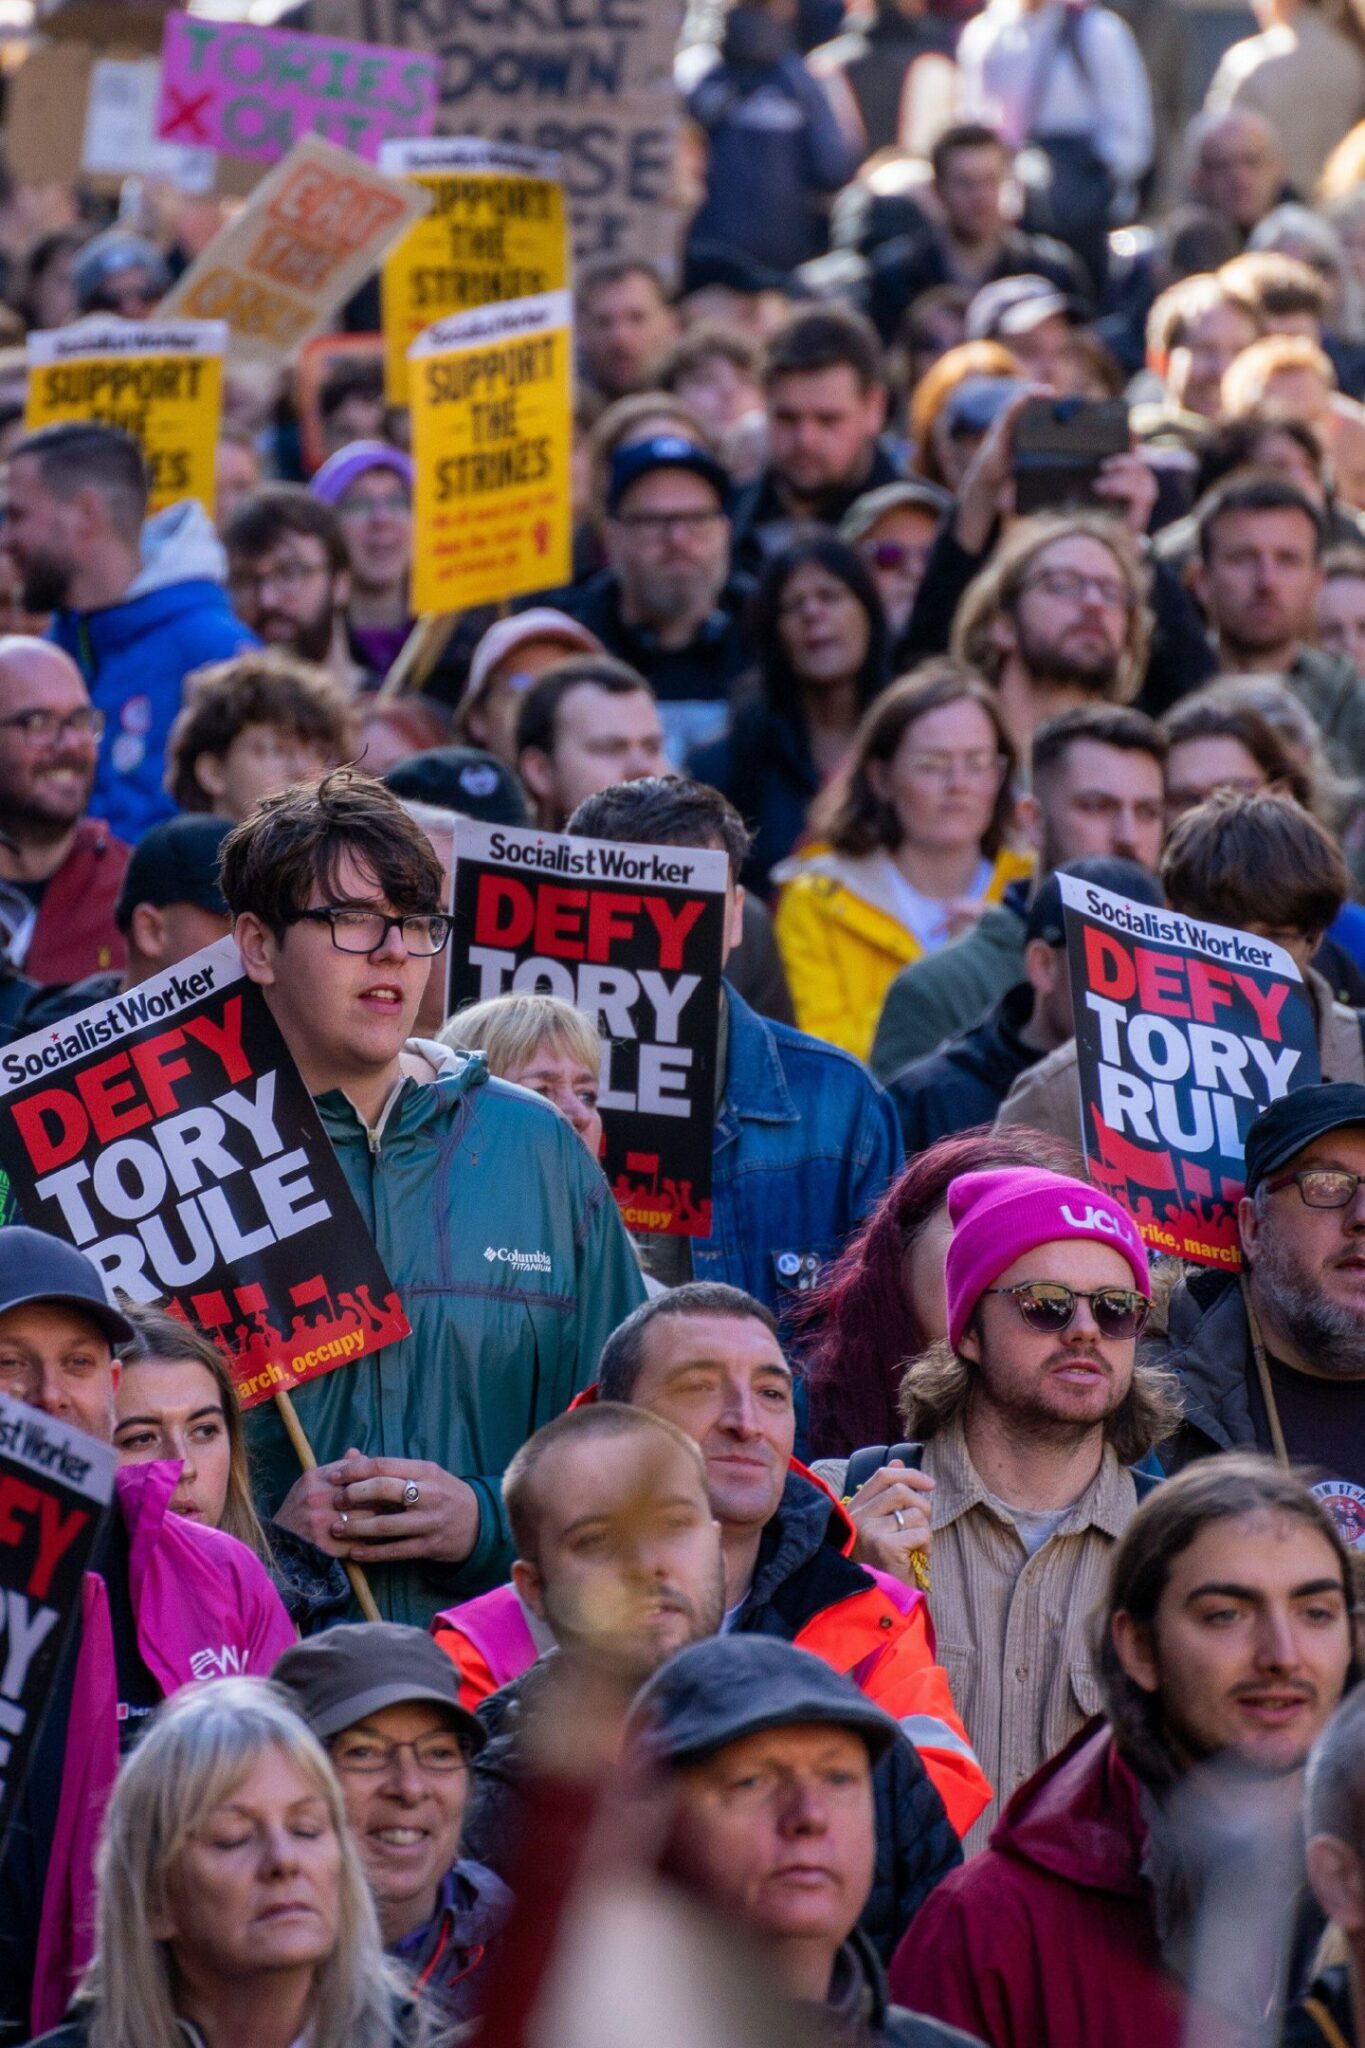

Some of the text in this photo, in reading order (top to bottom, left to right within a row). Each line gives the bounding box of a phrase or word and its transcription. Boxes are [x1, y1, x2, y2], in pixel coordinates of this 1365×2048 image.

[182, 25, 435, 117] TORIES
[437, 40, 624, 100] DOWN
[267, 162, 407, 249] EAT
[430, 180, 551, 220] UPPORT
[449, 223, 506, 262] THE
[44, 360, 205, 410] SUPPORT
[425, 336, 557, 403] SUPPORT
[470, 398, 518, 444] THE
[435, 437, 552, 502] STRIKES
[489, 832, 694, 884] Socialist Worker
[475, 873, 706, 970] DEFY
[1086, 889, 1273, 968] Socialist Worker
[1083, 924, 1290, 1042] DEFY
[2, 964, 214, 1083] Socialist Worker
[1085, 991, 1302, 1101] TORY
[10, 995, 253, 1174] DEFY
[599, 1041, 692, 1118] LE
[1097, 1062, 1252, 1160] RUL
[34, 1070, 284, 1246] TORY
[80, 1148, 332, 1308] RULE
[619, 1206, 672, 1230] ccupy
[1136, 1221, 1241, 1263] rike, march
[497, 1248, 551, 1265] Columbia
[511, 1262, 552, 1272] TITANIUM
[238, 1329, 366, 1398] arch, occupy
[0, 1475, 91, 1600] FY
